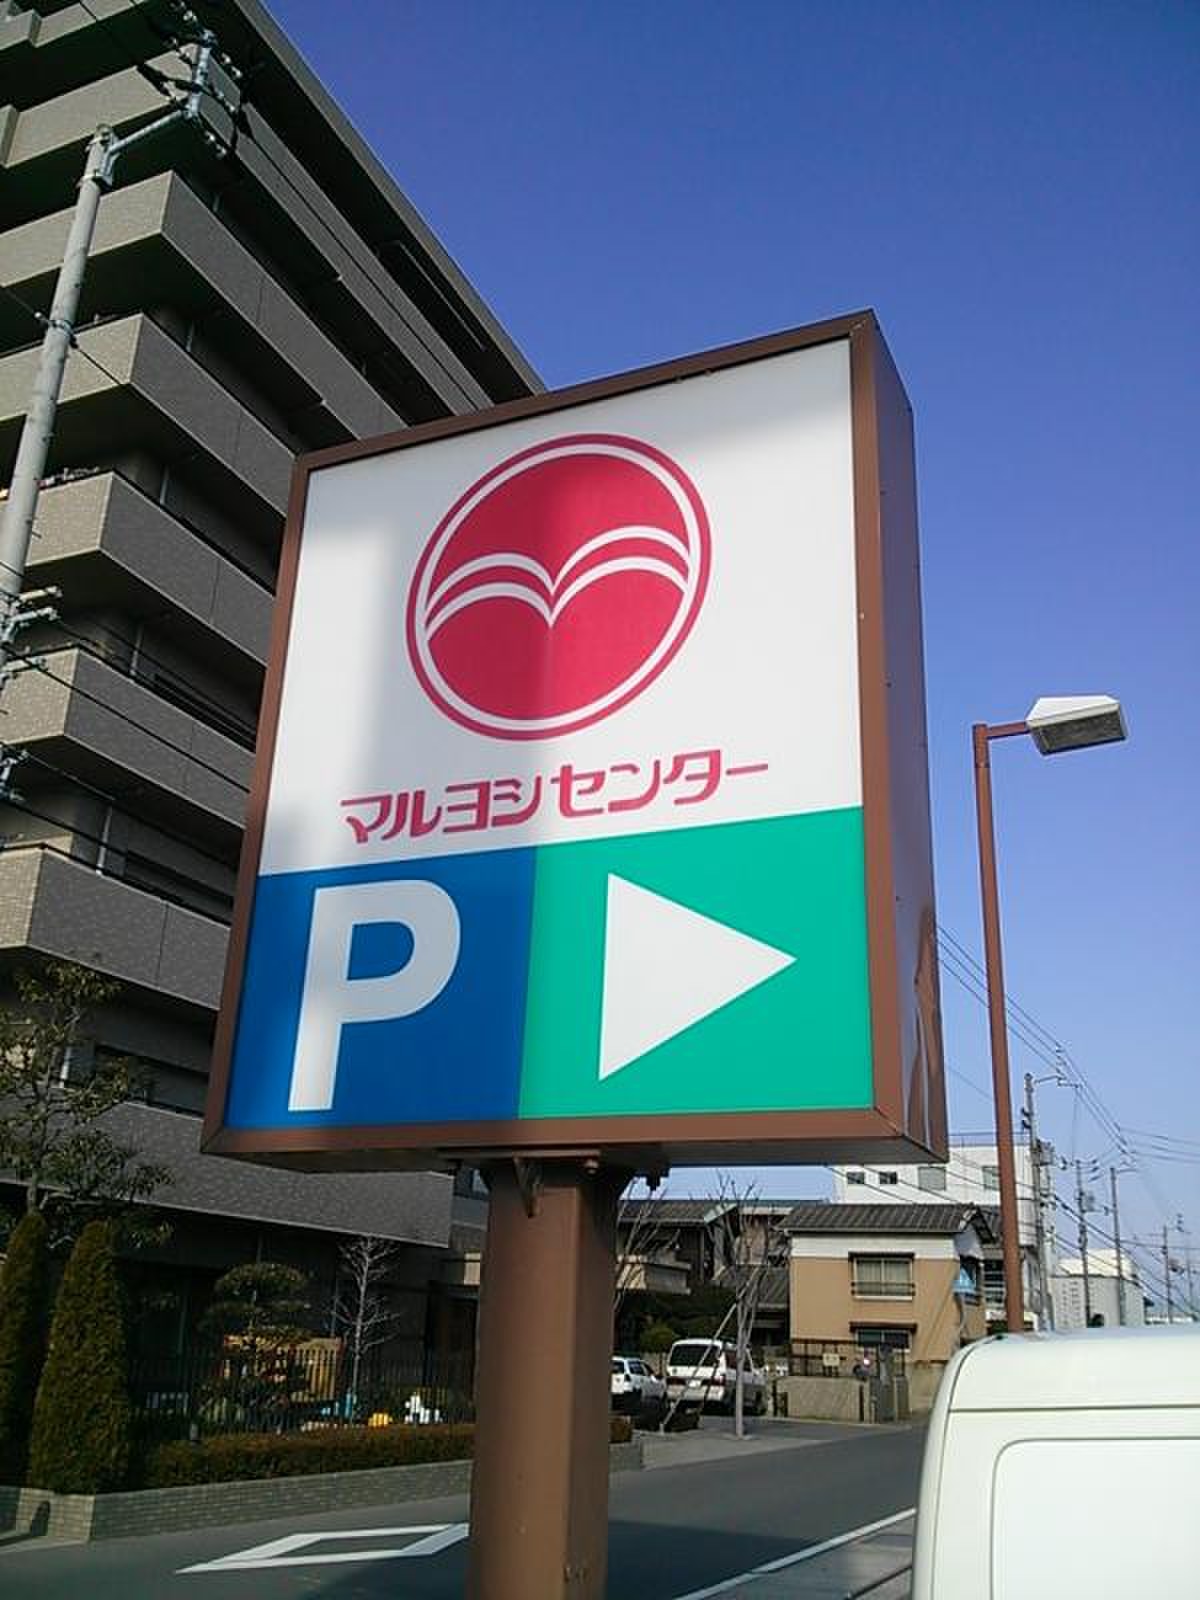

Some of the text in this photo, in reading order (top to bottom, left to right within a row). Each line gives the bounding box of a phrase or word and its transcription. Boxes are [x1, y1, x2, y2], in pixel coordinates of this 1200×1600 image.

[340, 749, 768, 844] マルヨシセンター
[288, 879, 461, 1111] P
